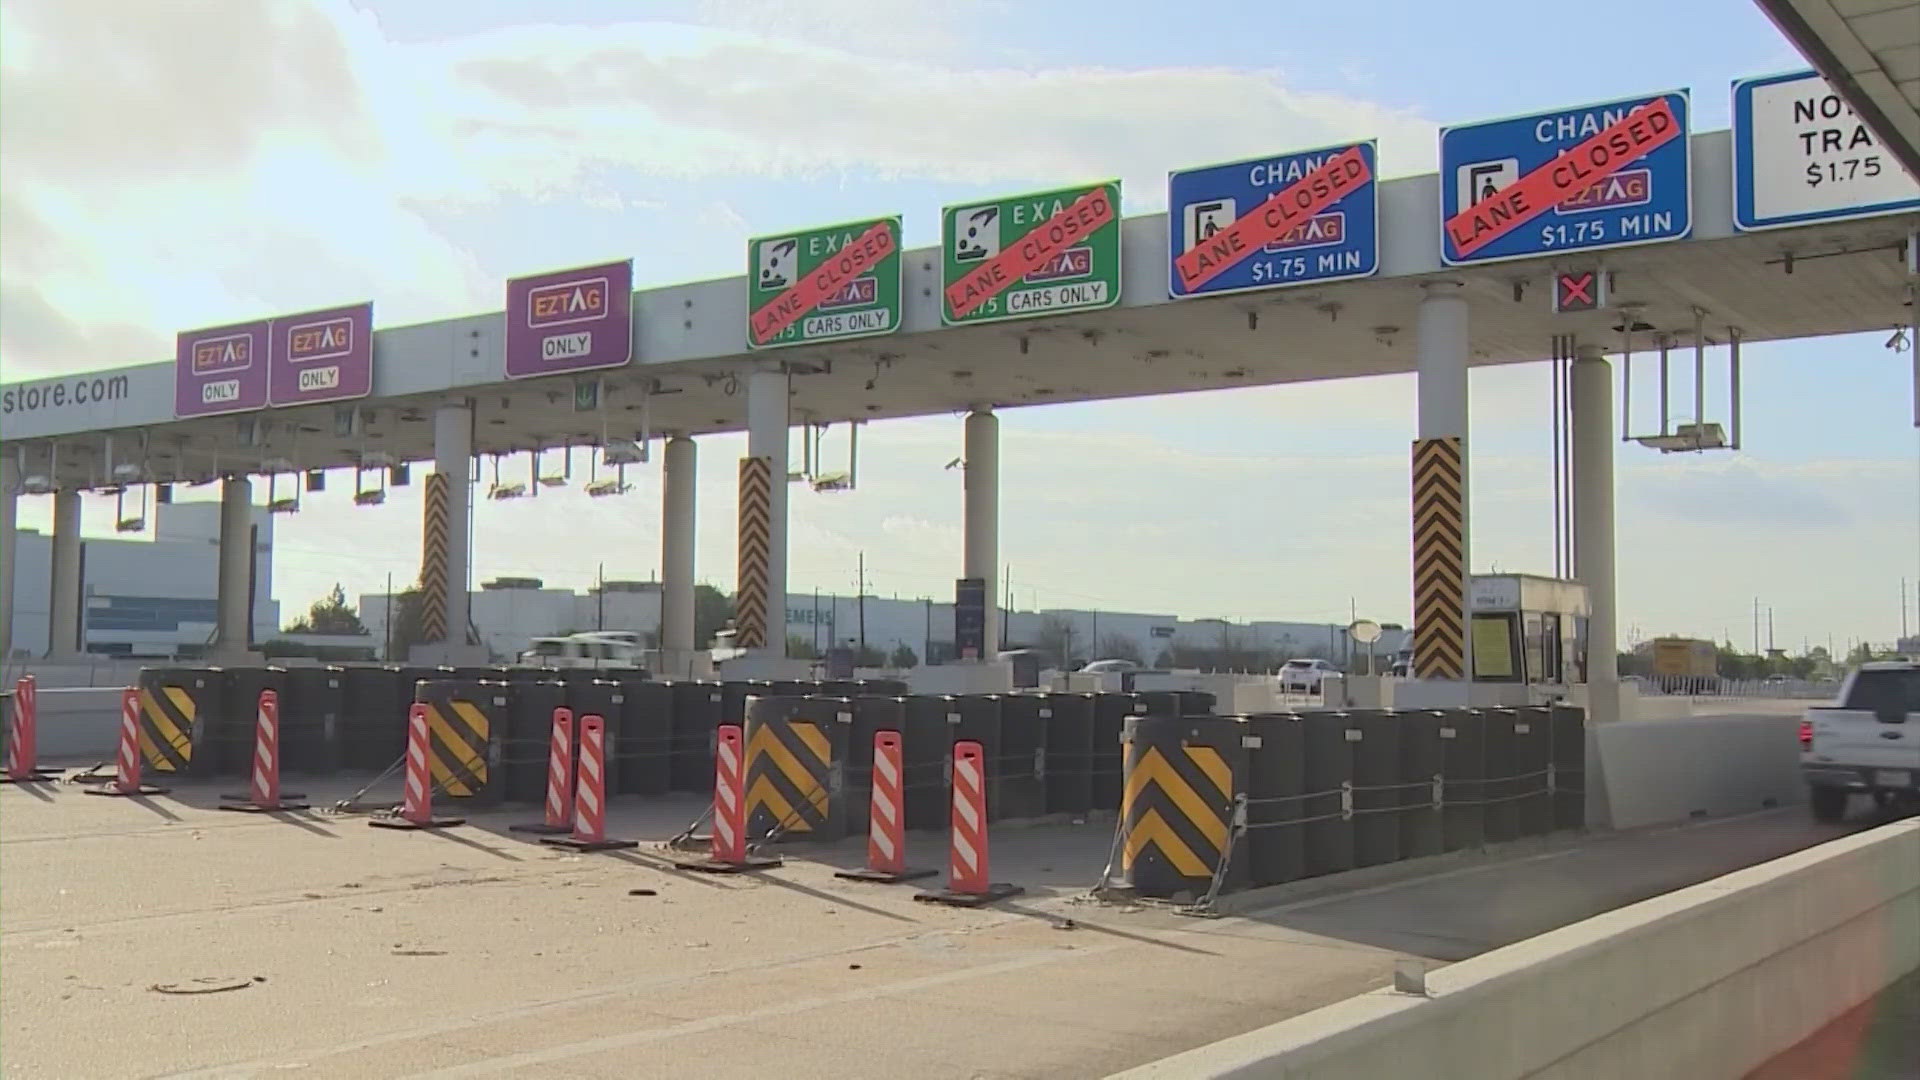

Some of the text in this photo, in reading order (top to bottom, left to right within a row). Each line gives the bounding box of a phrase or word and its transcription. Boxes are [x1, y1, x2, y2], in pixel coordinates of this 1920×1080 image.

[1535, 105, 1647, 143] CHAN
[1793, 95, 1853, 123] NO
[1799, 125, 1872, 156] TRA
[1250, 153, 1341, 187] CHAN
[1453, 111, 1670, 247] LANE CLOSED
[1806, 156, 1881, 188] $1.75
[1181, 158, 1362, 282] LANE CLOSED
[1541, 211, 1672, 248] $1.75 MIN
[951, 199, 1106, 309] LANE CLOSED
[1252, 250, 1361, 282] $1.75 MIN
[755, 232, 888, 335] LANE CLOSED
[1011, 284, 1102, 310] CARS ONLY
[535, 287, 600, 316] EZTAG
[293, 326, 347, 352] EZTAG
[807, 312, 885, 335] CARS ONLY
[197, 341, 246, 367] EZTAG
[545, 335, 588, 356] ONLY
[204, 384, 236, 400] ONLY
[302, 369, 337, 387] ONLY
[3, 375, 129, 414] store.com
[785, 609, 832, 626] EMENS
